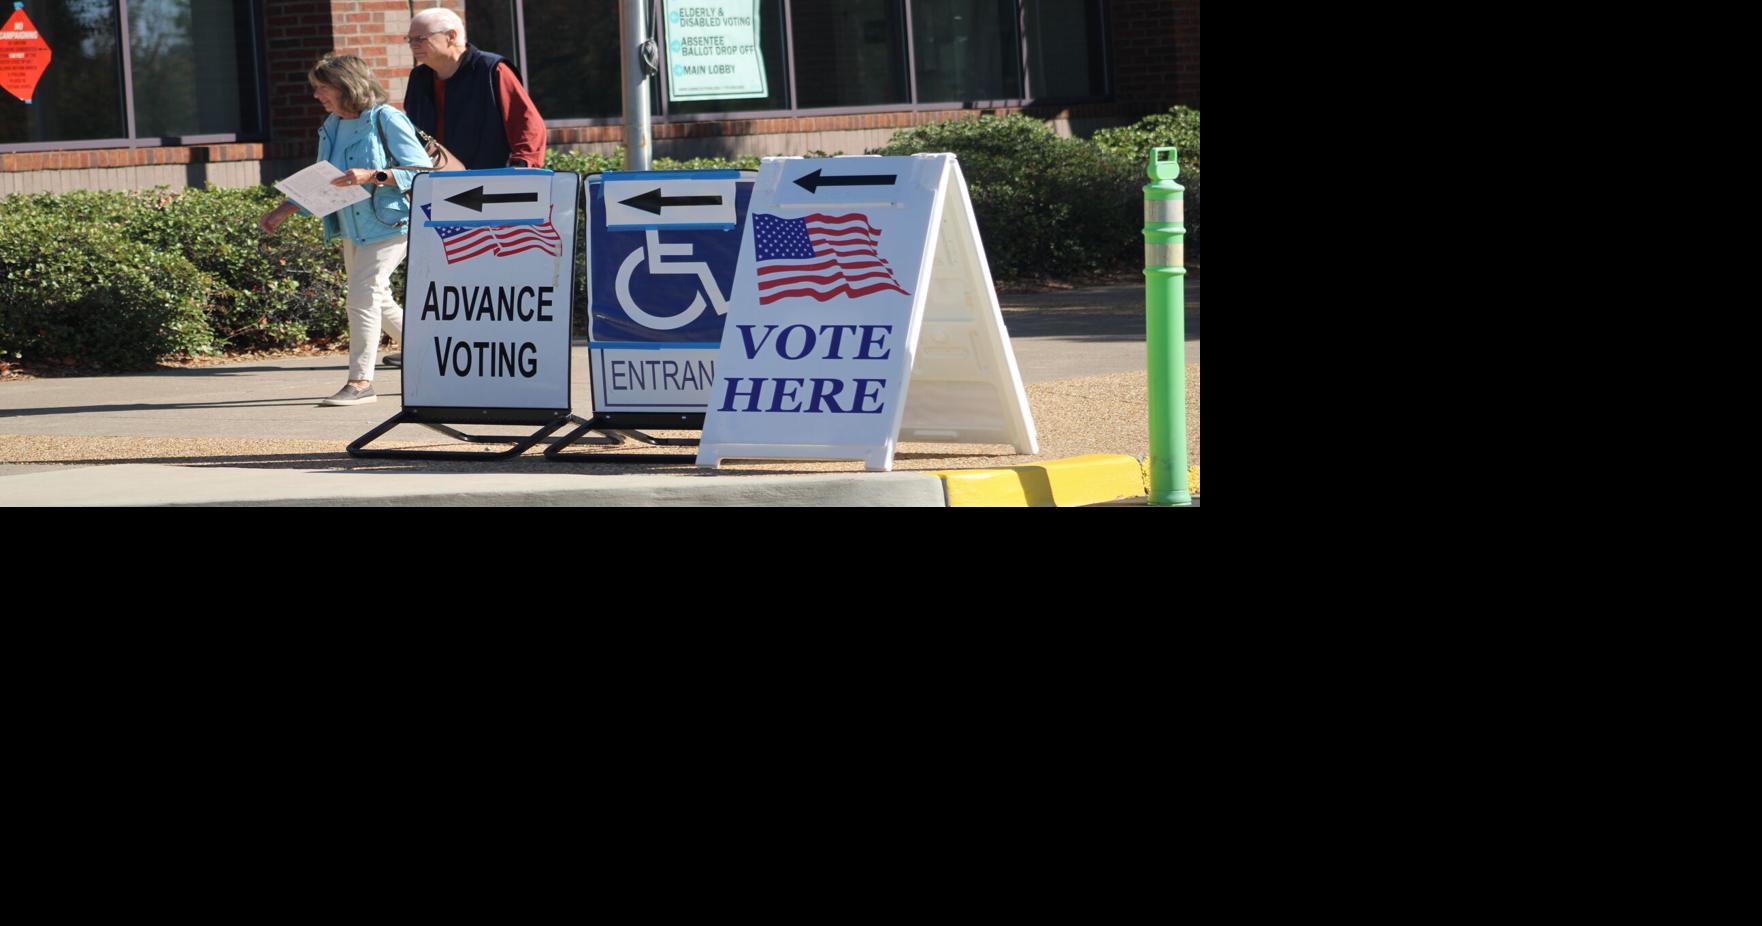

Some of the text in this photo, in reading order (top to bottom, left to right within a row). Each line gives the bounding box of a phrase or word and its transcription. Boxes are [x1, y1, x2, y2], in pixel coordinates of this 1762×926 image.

[679, 8, 724, 17] ELDERLY &
[680, 17, 751, 27] DISABLED VOTING
[681, 36, 725, 46] ABSENTEE
[682, 45, 755, 56] BALLOT DROP OFF
[684, 64, 736, 75] MAIN LOBBY
[421, 281, 554, 322] ADVANCE
[735, 324, 893, 361] VOTE
[434, 336, 538, 378] VOTING
[611, 360, 715, 391] ENTRAN
[717, 377, 887, 414] HERE
